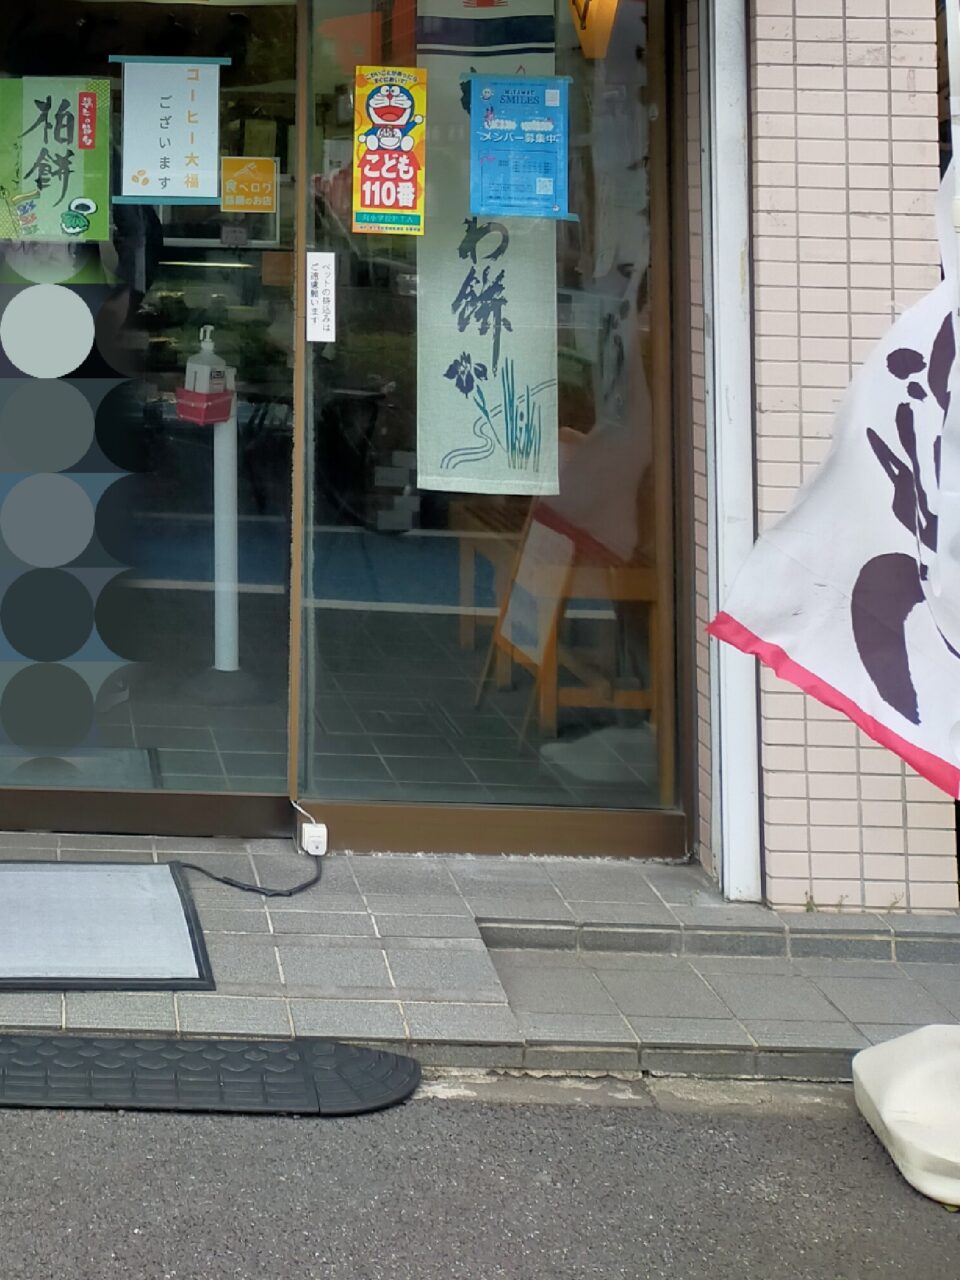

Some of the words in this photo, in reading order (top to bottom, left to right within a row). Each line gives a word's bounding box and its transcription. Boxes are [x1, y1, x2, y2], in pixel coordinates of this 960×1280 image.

[18, 95, 75, 208] 柏餅
[158, 94, 173, 190] ございます
[184, 67, 200, 189] コーヒー大福
[363, 153, 415, 181] こども
[362, 180, 416, 208] 110番
[450, 216, 514, 379] わ餅
